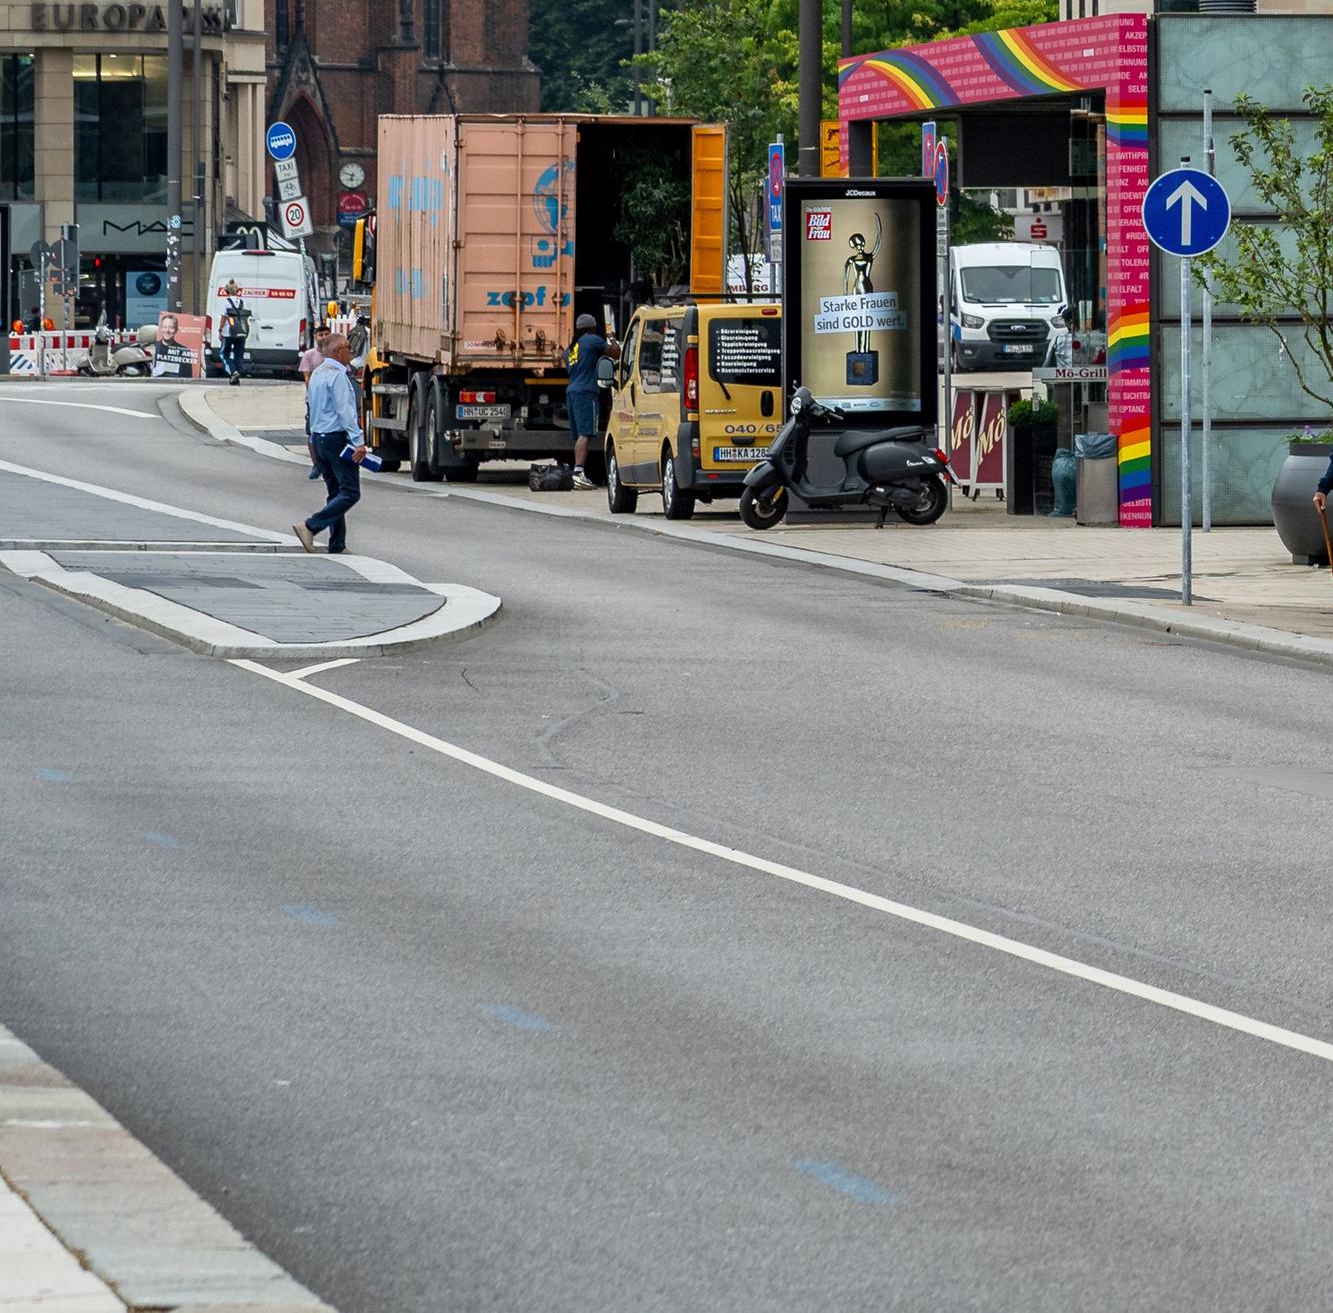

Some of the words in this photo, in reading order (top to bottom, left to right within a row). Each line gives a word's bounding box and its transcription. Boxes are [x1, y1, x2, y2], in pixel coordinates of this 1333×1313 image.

[31, 3, 166, 31] EUROPA
[278, 161, 294, 172] TAXI
[289, 209, 300, 221] 20
[808, 214, 830, 227] Bild
[808, 227, 830, 239] Frau
[823, 299, 857, 313] Starke
[860, 297, 896, 310] Frauen
[817, 318, 839, 331] sind
[843, 316, 873, 329] GOLD
[877, 315, 905, 327] wert.
[1056, 369, 1107, 379] Mö-Grill
[464, 407, 474, 416] HH
[478, 407, 488, 416] UC
[720, 449, 732, 458] HH
[738, 449, 749, 458] KA
